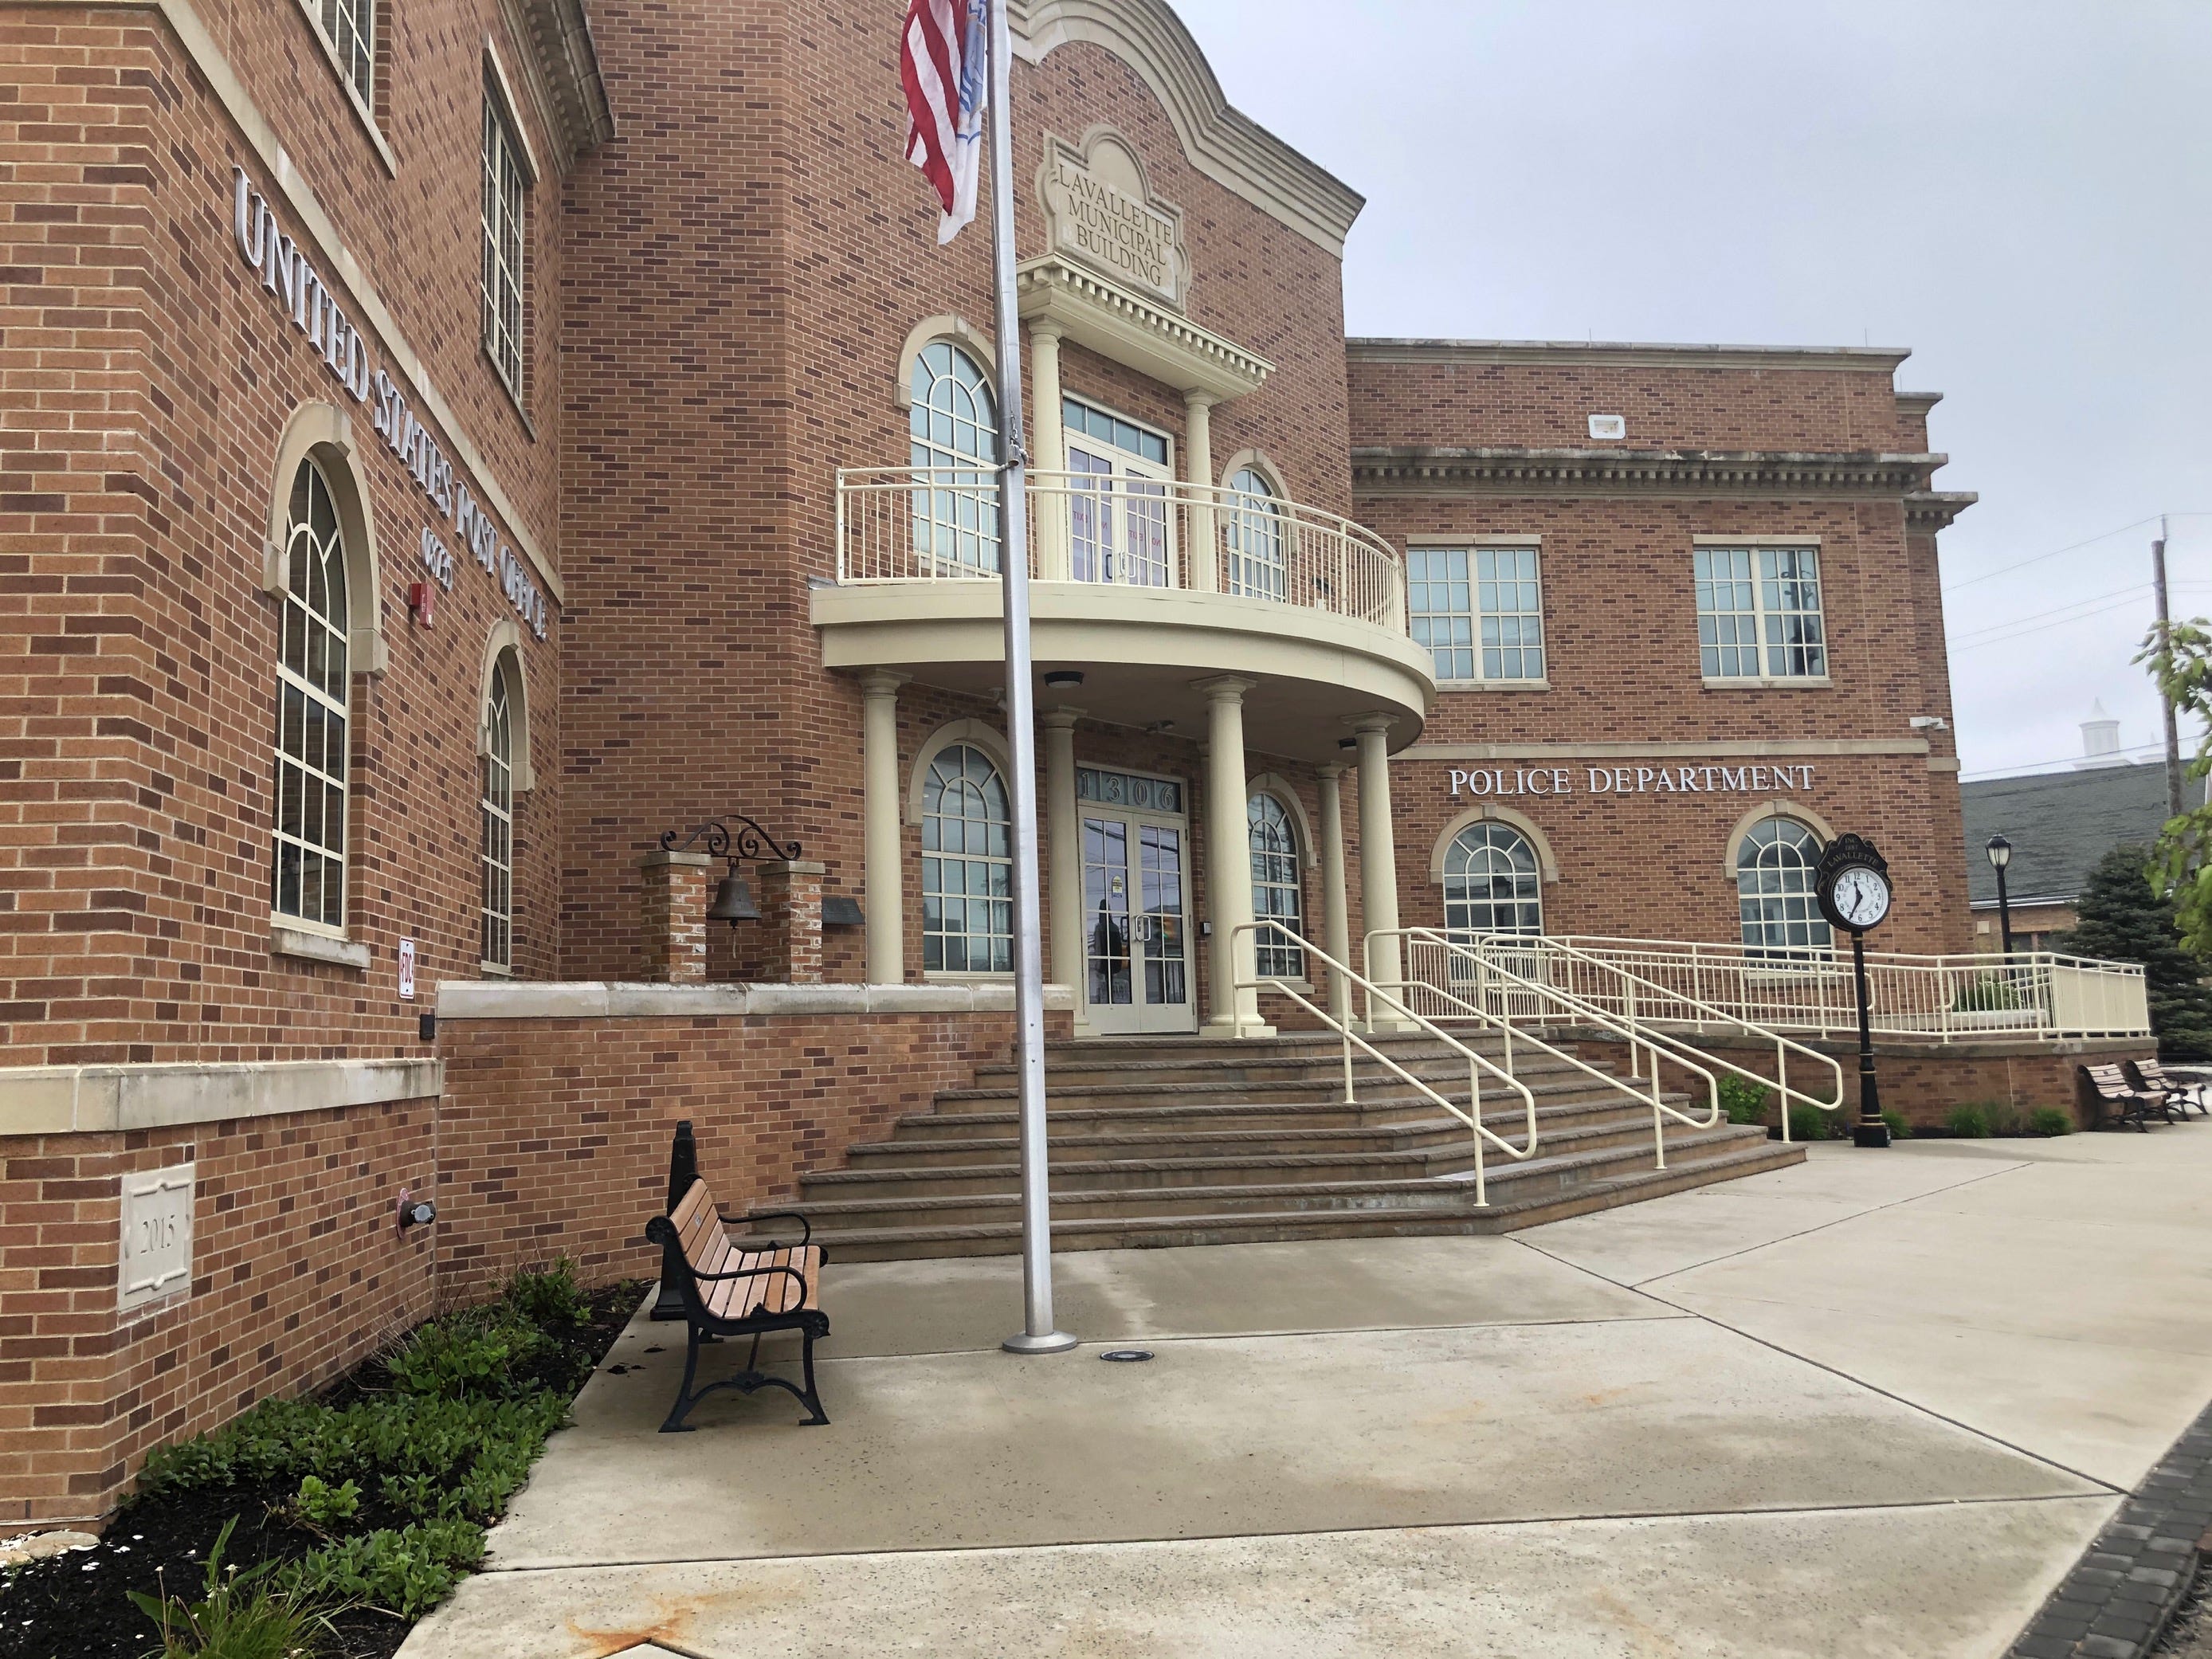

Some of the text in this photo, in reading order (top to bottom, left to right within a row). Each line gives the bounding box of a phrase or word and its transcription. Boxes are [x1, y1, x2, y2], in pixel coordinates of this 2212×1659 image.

[1058, 163, 1173, 245] LAVALLETTE
[1068, 194, 1167, 266] MUNICIPAL
[1077, 223, 1161, 287] BUILDING
[233, 164, 547, 641] UNITED STATES POST OFFICE
[1081, 771, 1175, 811] 1306
[1449, 765, 1816, 795] POLICE DEPARTMENT
[1828, 852, 1879, 867] LAVALLETTE
[402, 951, 412, 984] FDC
[140, 1214, 175, 1254] 2015
